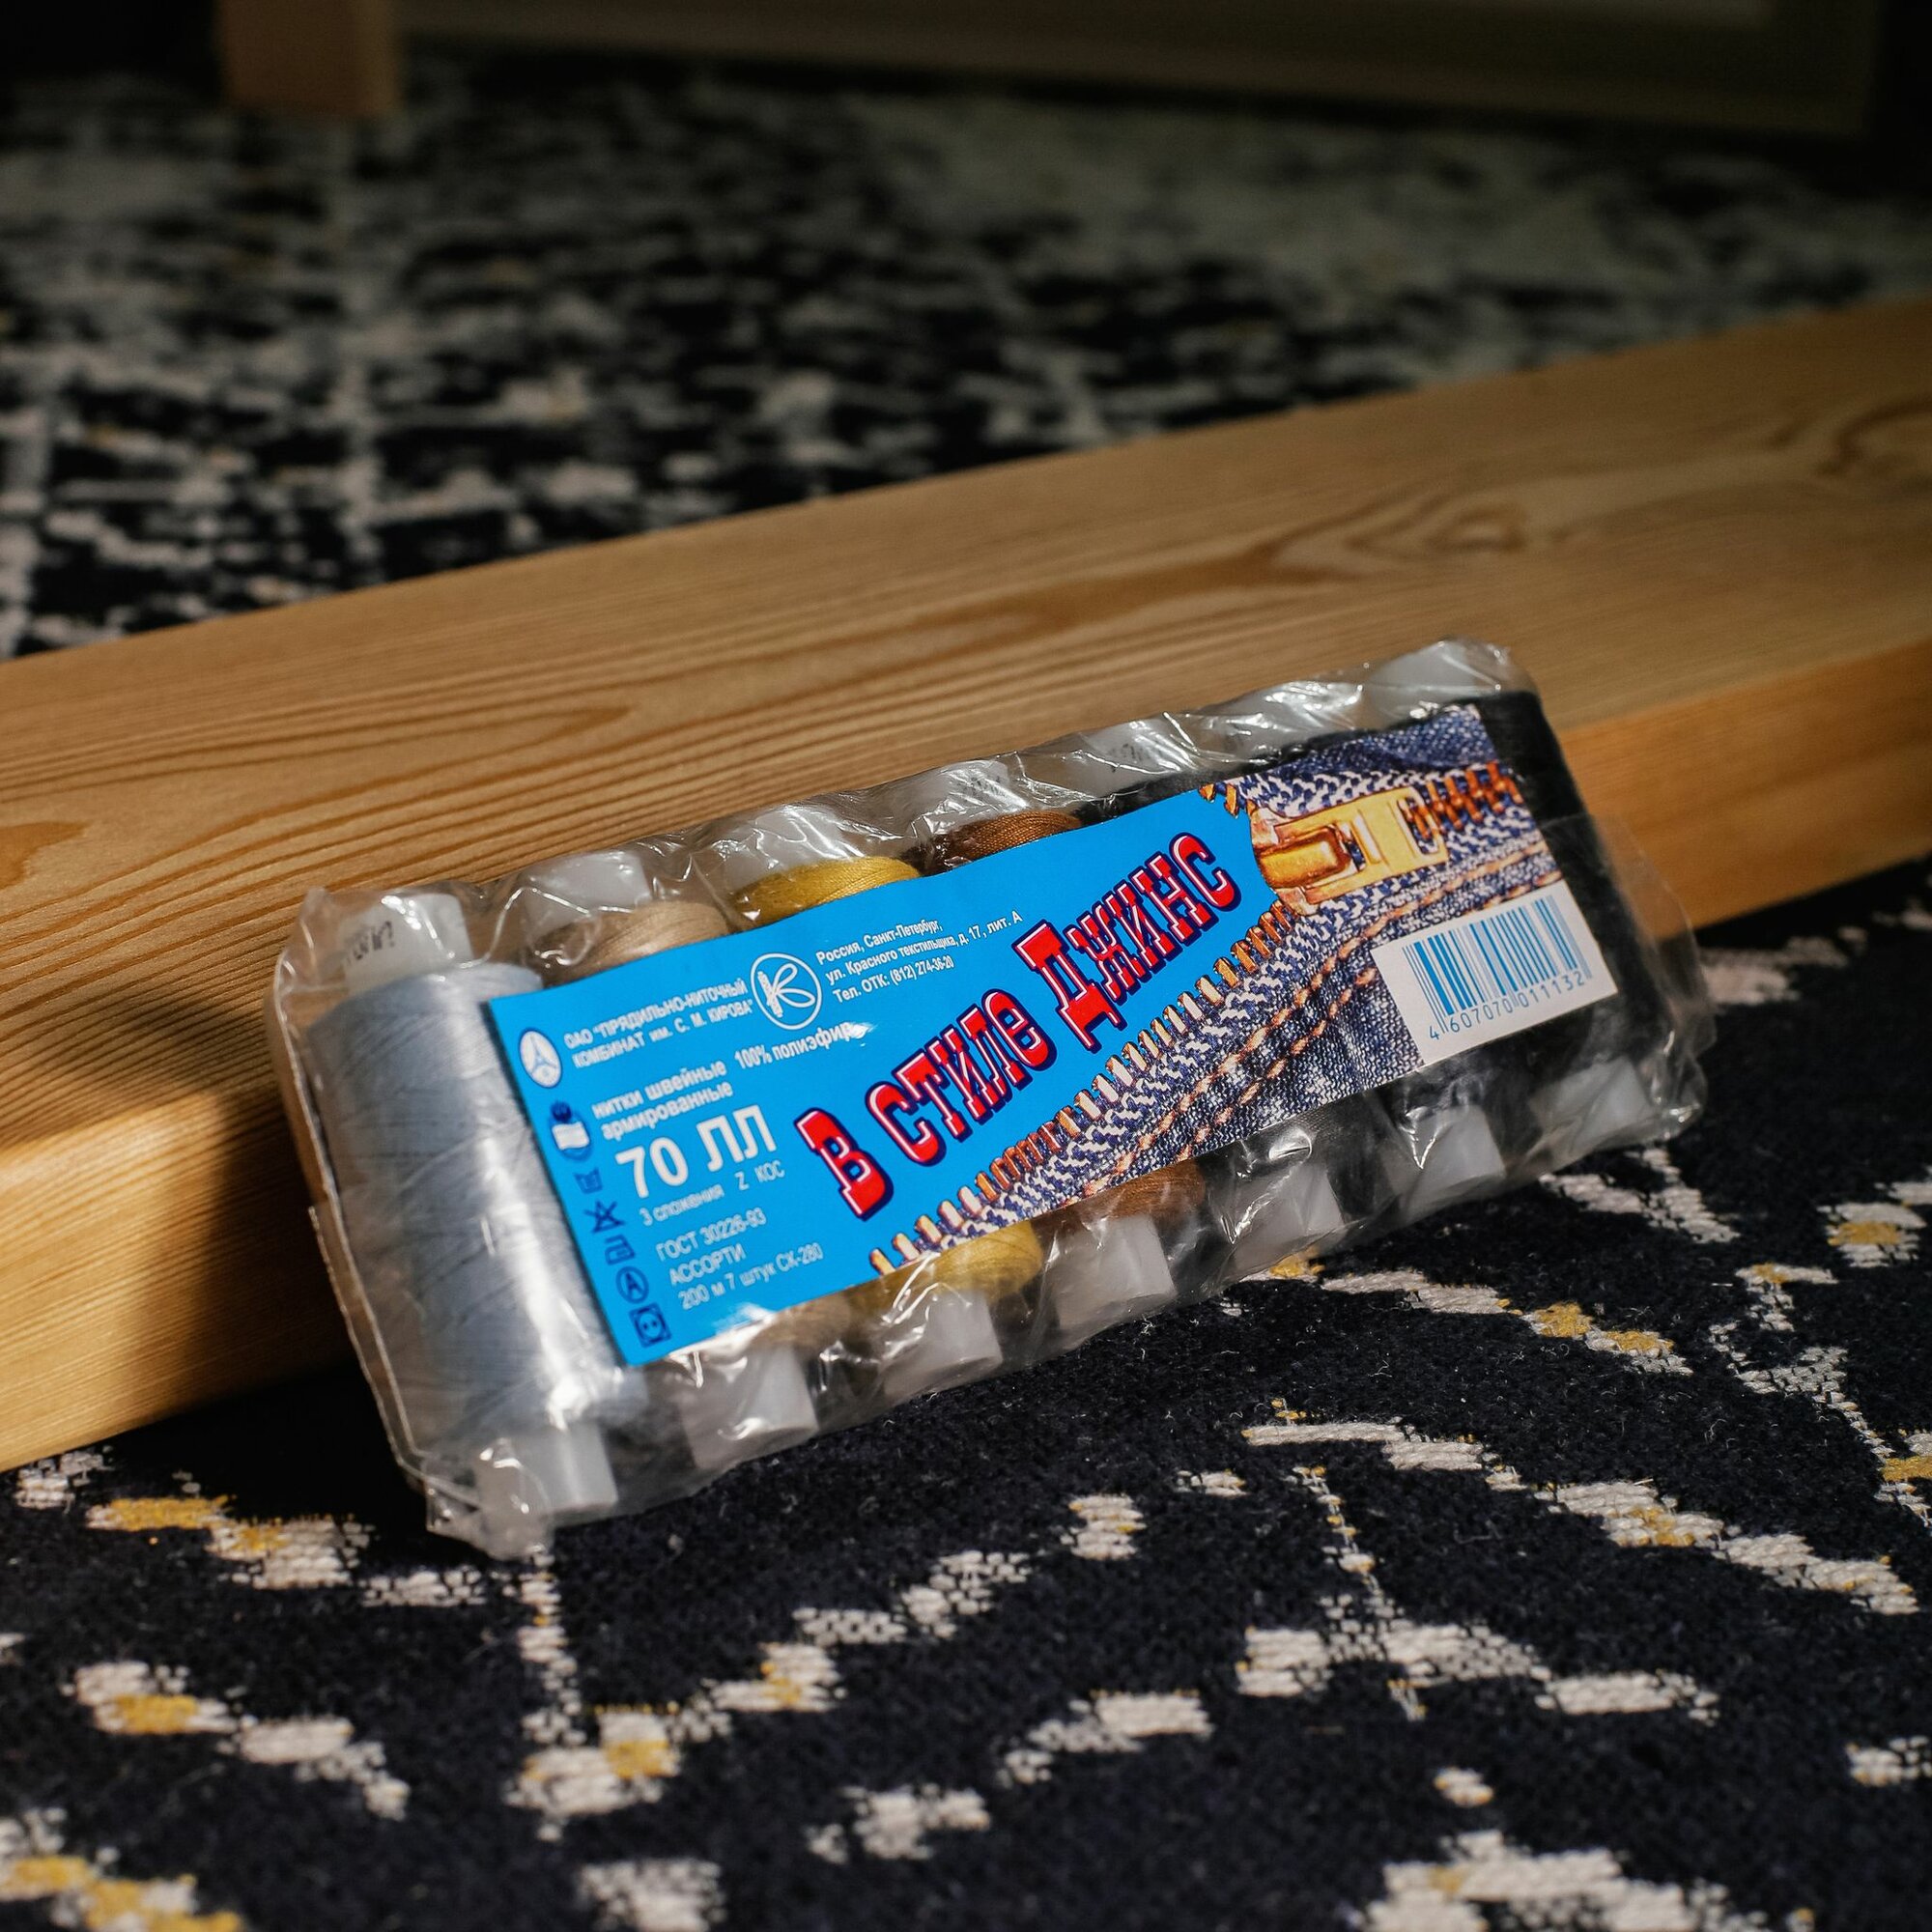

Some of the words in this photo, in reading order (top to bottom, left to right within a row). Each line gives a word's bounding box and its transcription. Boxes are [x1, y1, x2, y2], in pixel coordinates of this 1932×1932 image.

[816, 942, 866, 967] Россия,
[864, 919, 944, 950] Санкт-Петербург,
[826, 967, 845, 986] ул.
[846, 950, 898, 978] Красного
[987, 918, 1011, 935] лит.
[834, 986, 862, 1004] Тел.
[862, 975, 891, 994] ОТК:
[890, 963, 917, 987] (812)
[918, 955, 954, 978] 274-36-20
[565, 1028, 593, 1049] ОАО
[573, 1033, 646, 1068] КОМБИНАТ
[735, 1044, 773, 1069] 100%
[592, 1090, 644, 1120] нитки
[645, 1062, 727, 1101] швейные
[602, 1082, 734, 1141] армированные
[615, 1137, 689, 1199] 70
[696, 1105, 778, 1173] ЛЛ
[639, 1208, 654, 1227] 3
[653, 1184, 724, 1223] сложения
[656, 1231, 699, 1263] ГОСТ
[669, 1243, 747, 1287] АССОРТИ
[678, 1285, 710, 1311] 200
[724, 1273, 737, 1292] 7
[739, 1261, 778, 1288] штук
